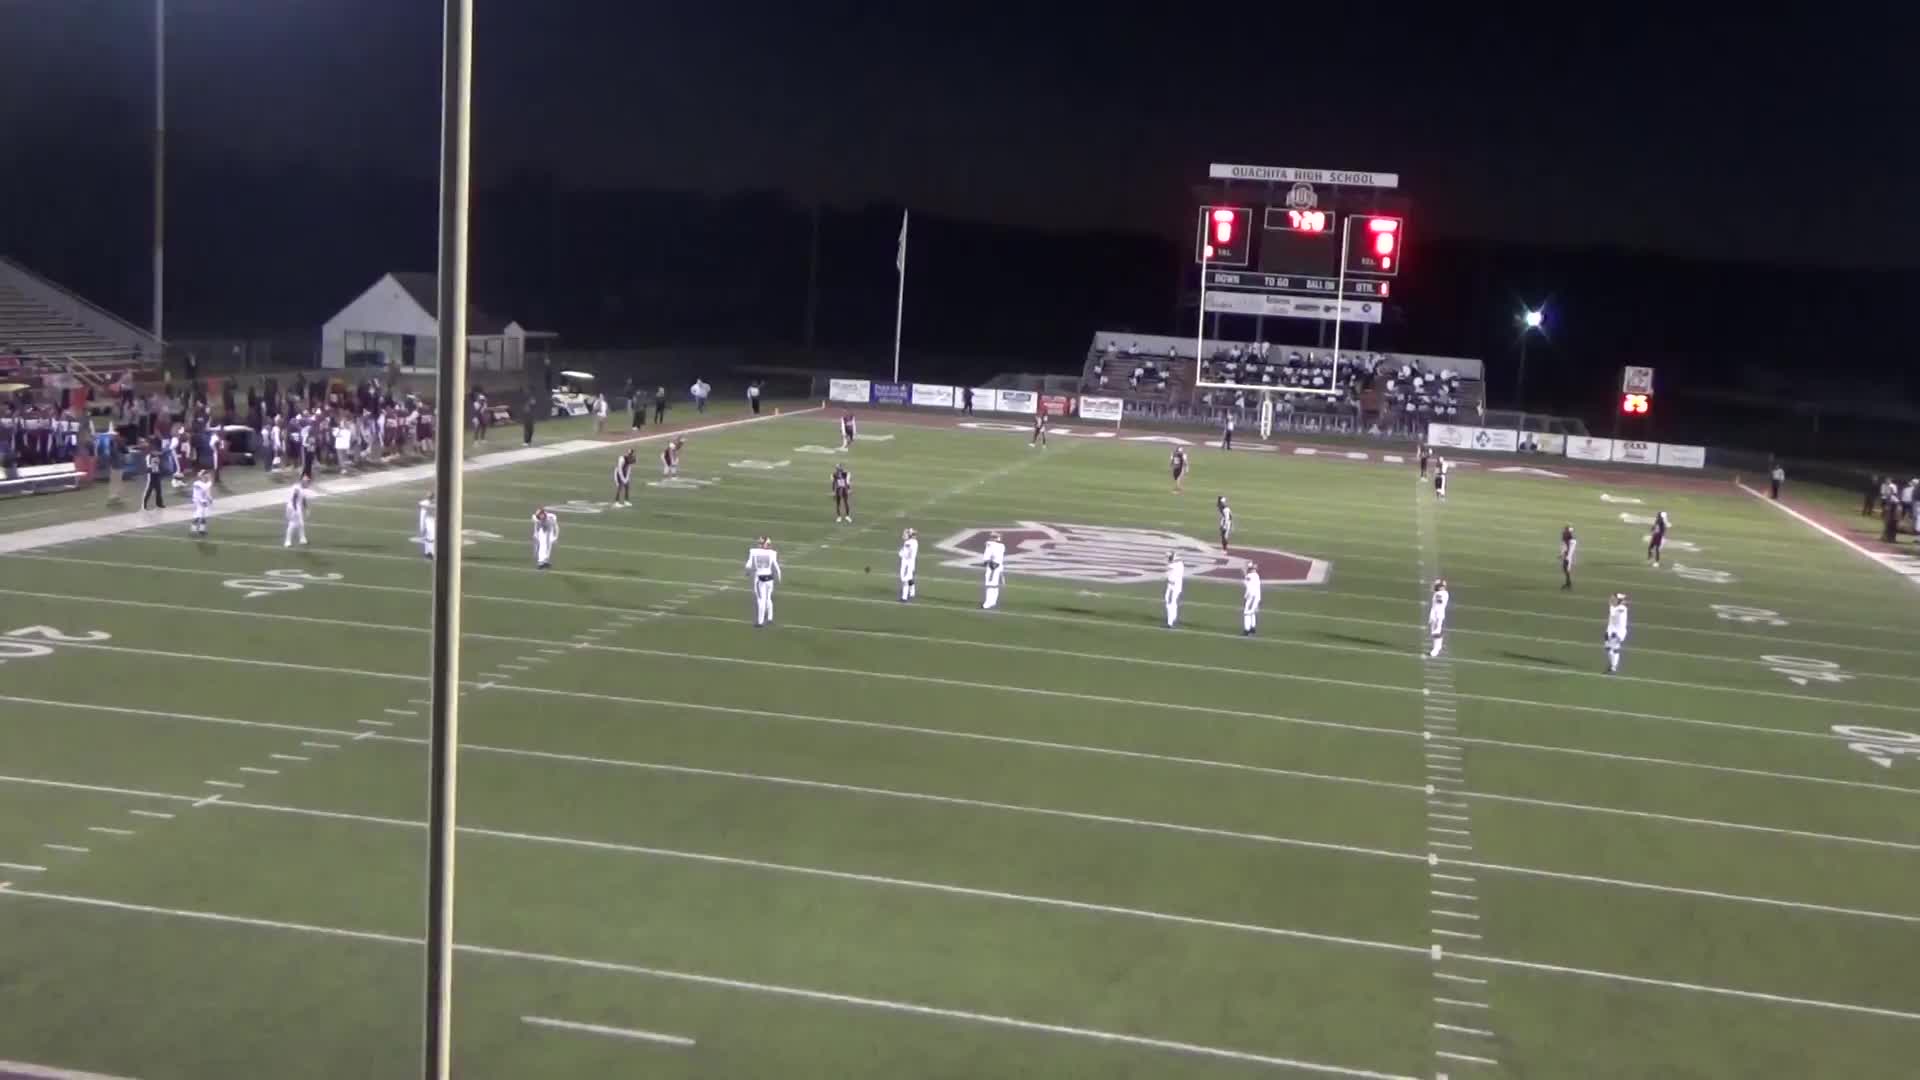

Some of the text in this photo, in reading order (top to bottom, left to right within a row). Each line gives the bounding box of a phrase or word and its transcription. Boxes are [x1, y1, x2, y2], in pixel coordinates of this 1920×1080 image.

[1232, 166, 1375, 185] OUACHITA HIGH SCHOOL
[1214, 273, 1240, 285] DOWN
[1264, 276, 1289, 288] TO GO
[1306, 279, 1323, 290] BALL
